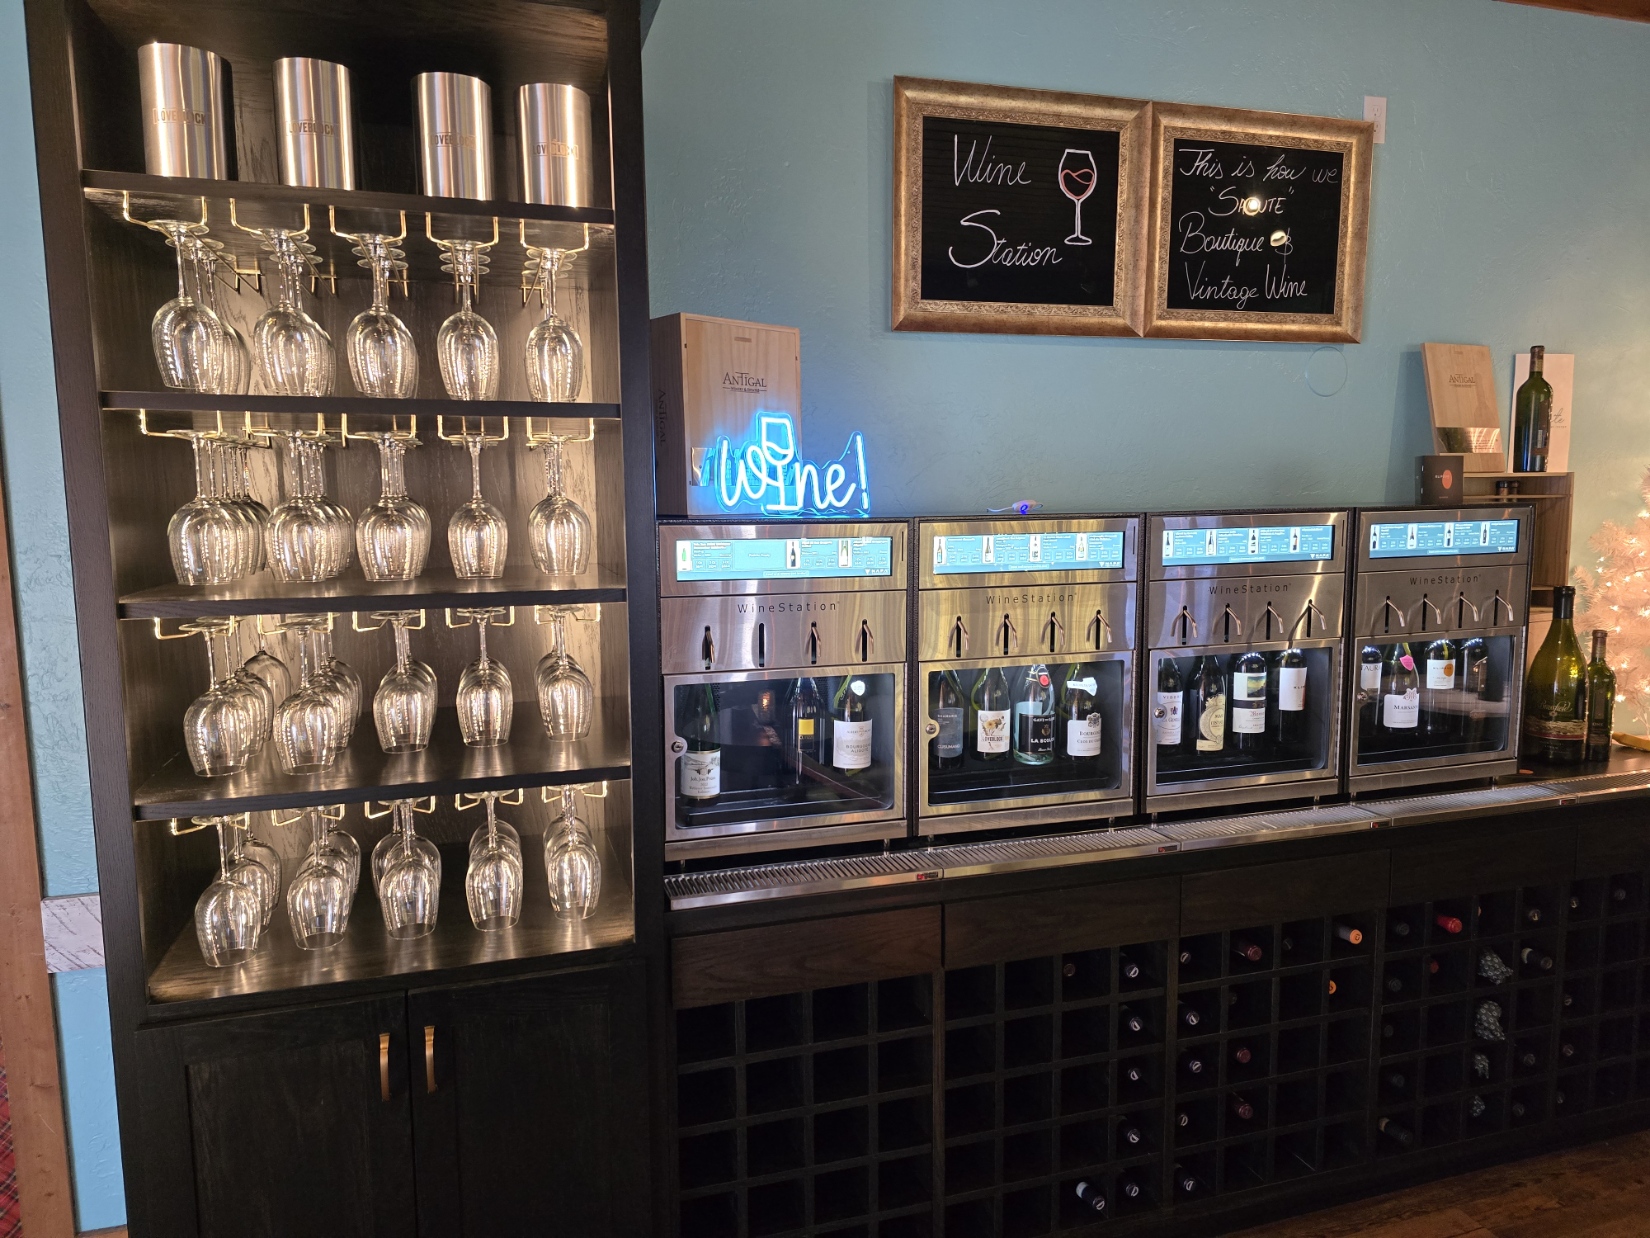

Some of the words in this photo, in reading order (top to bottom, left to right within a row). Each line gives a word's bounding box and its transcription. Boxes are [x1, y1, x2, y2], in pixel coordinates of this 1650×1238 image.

[954, 134, 1032, 186] Wine
[1178, 148, 1223, 180] This
[1231, 156, 1255, 178] is
[1263, 154, 1306, 182] how
[1312, 168, 1338, 183] we
[948, 209, 1062, 269] Station
[1179, 211, 1265, 267] Boutique
[1184, 260, 1260, 309] Vintage
[1265, 264, 1308, 299] Wine
[1209, 583, 1288, 594] WineStation
[1409, 575, 1479, 585] WineStation
[737, 602, 836, 613] WineStation
[986, 593, 1074, 604] WineStation
